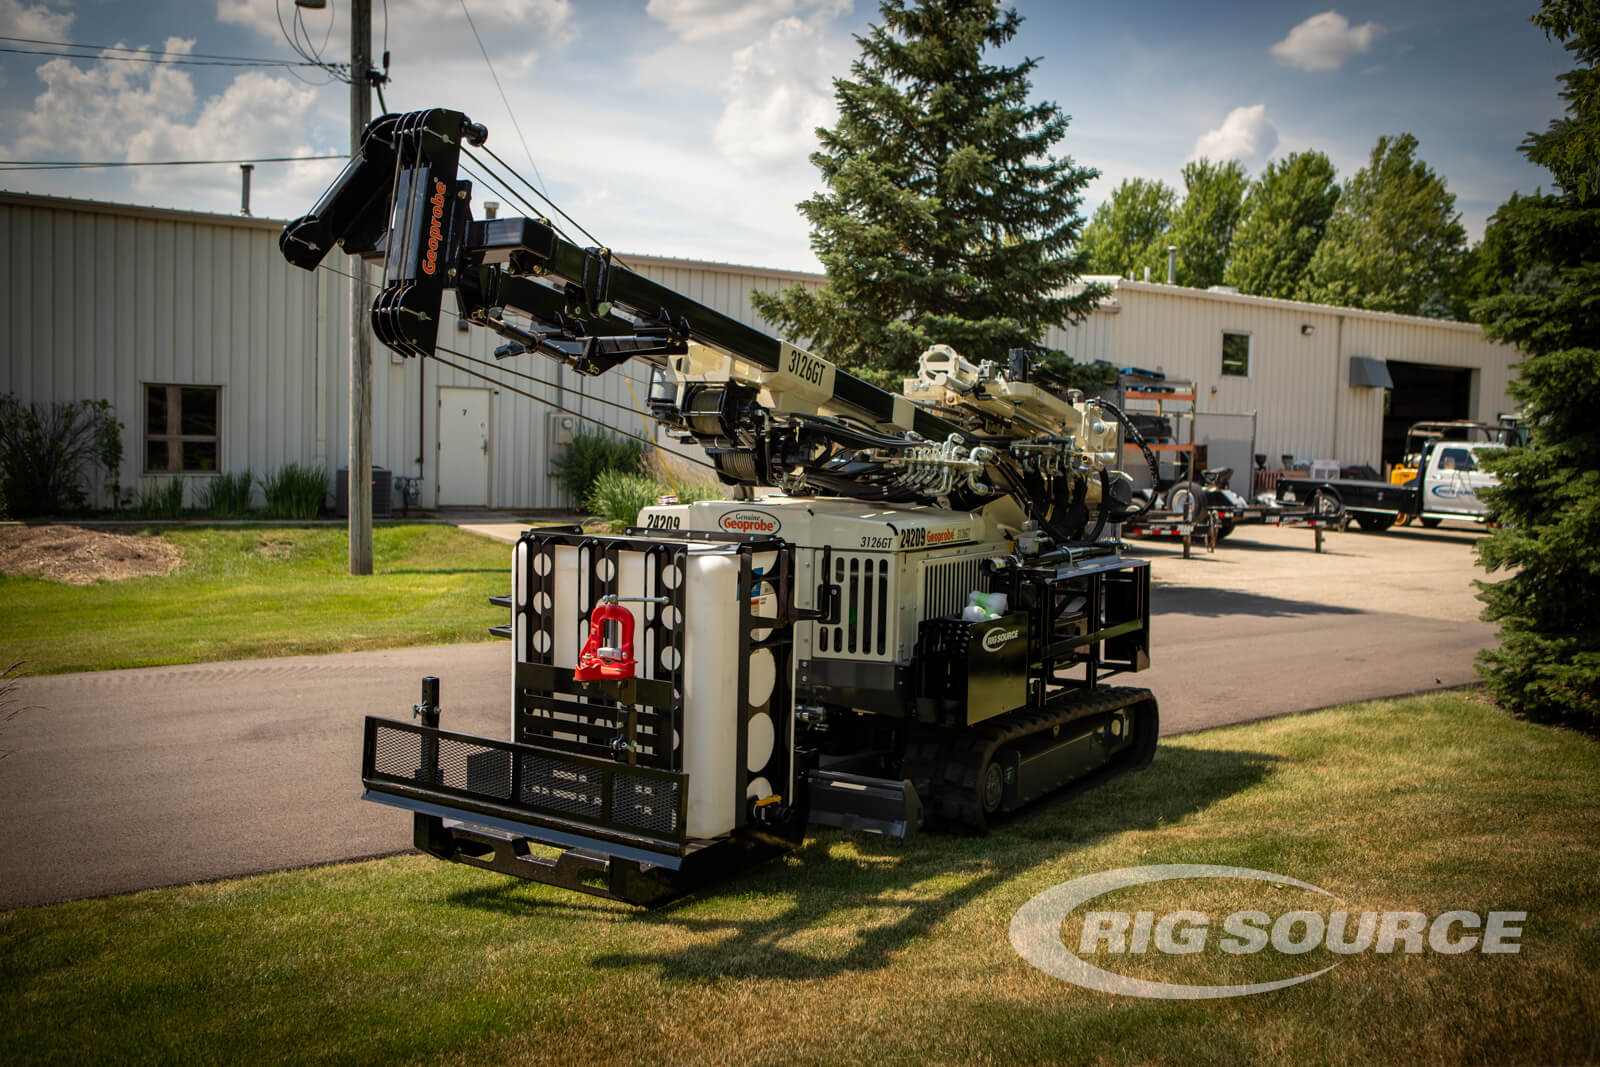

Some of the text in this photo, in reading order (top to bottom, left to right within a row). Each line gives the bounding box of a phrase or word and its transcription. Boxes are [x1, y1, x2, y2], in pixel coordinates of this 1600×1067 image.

[422, 180, 447, 275] Geoprobe
[788, 350, 826, 387] 3126GT
[735, 512, 761, 521] Genuine
[860, 536, 893, 549] 3126GT
[900, 527, 926, 548] 24209
